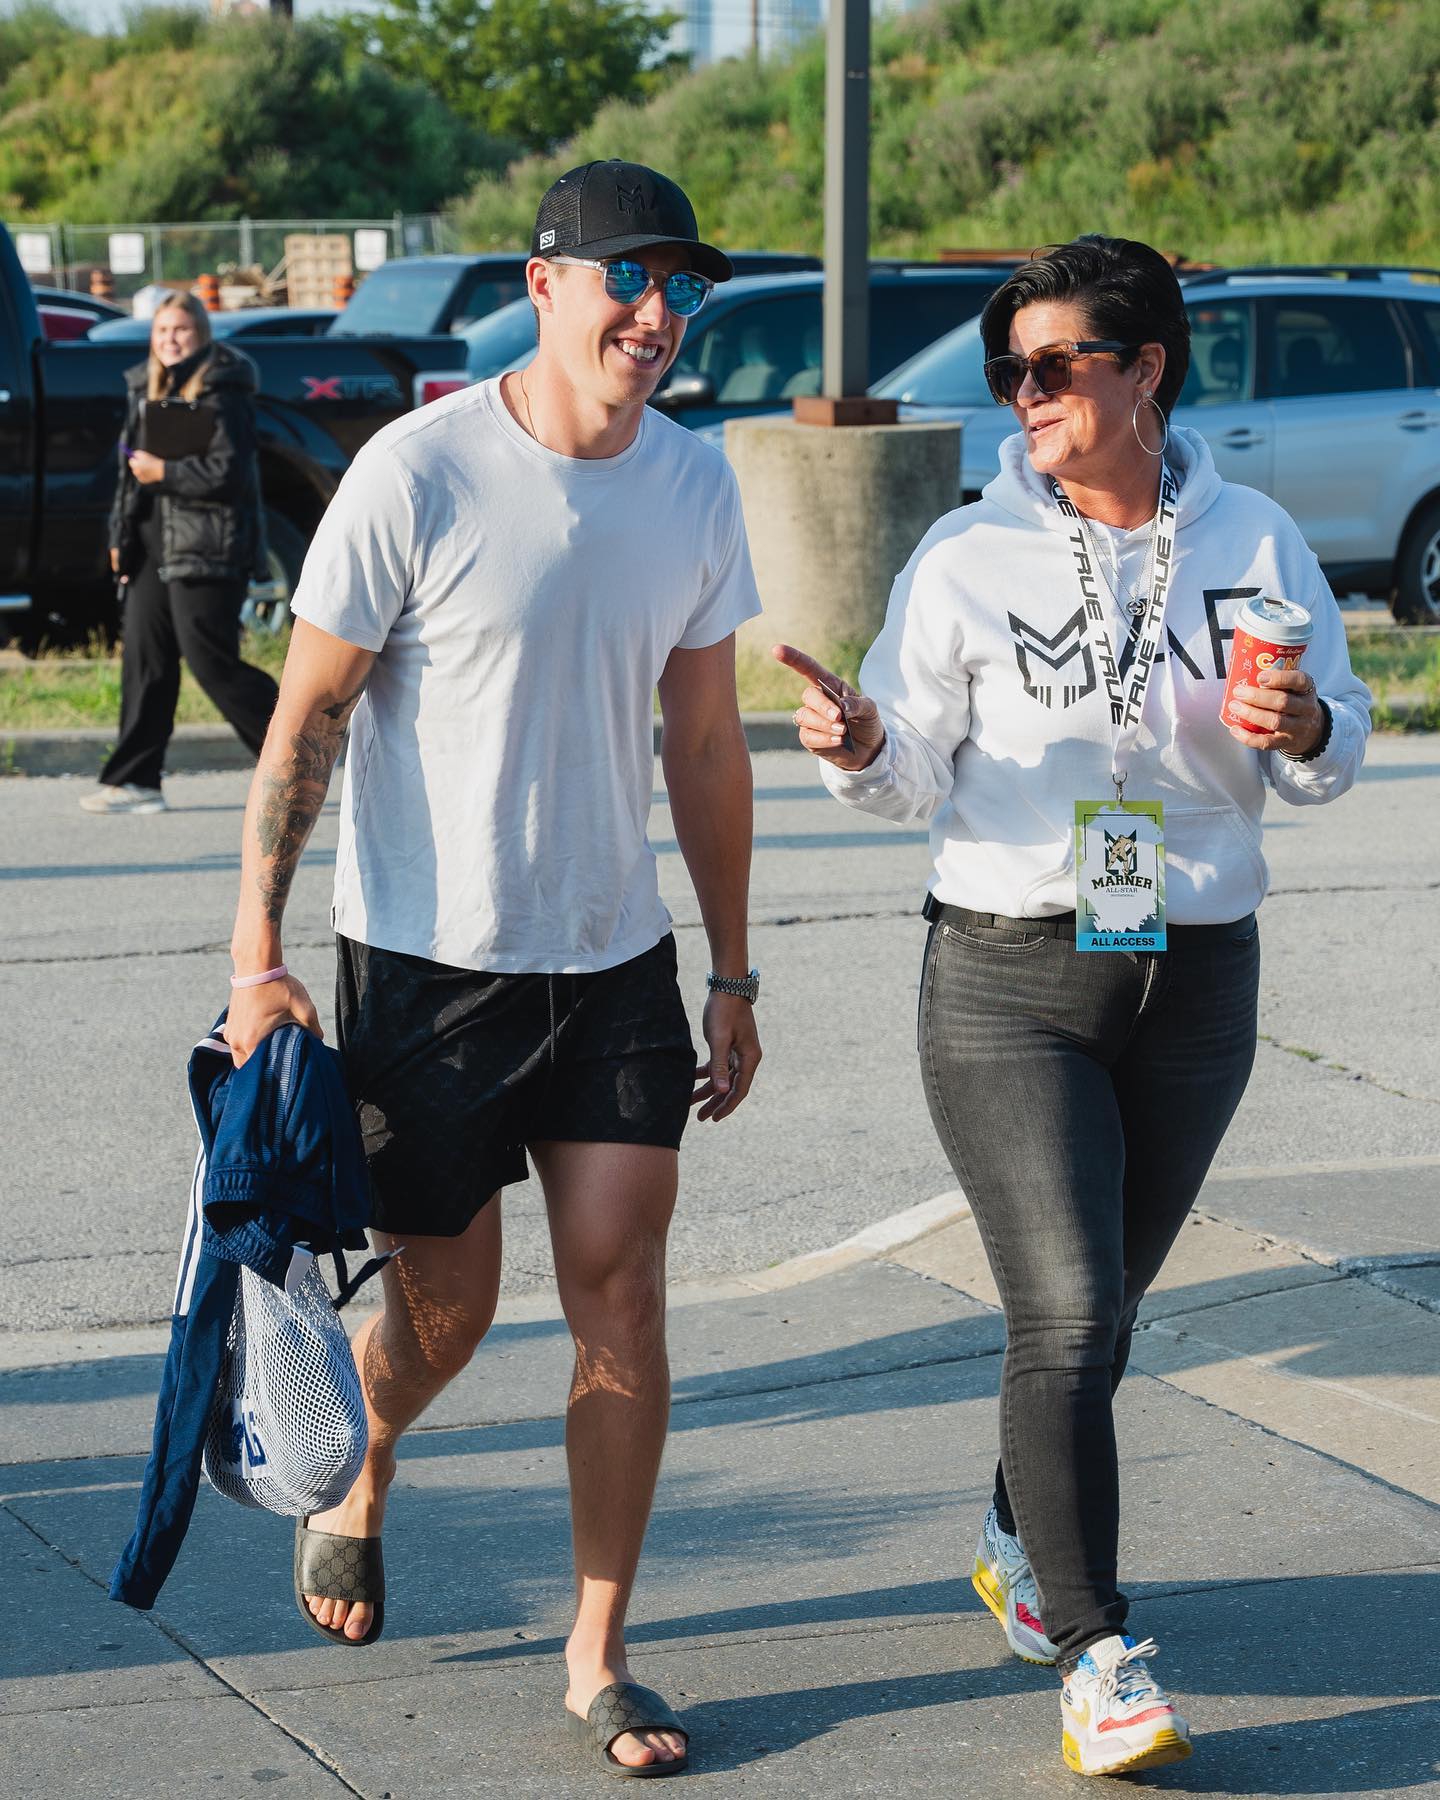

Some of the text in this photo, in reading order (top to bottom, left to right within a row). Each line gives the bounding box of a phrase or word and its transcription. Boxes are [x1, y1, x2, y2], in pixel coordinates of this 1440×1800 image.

[301, 376, 403, 400] XTR
[1069, 527, 1104, 621] TRUE
[1094, 630, 1124, 726] TRUE
[1123, 637, 1156, 730] TRUE
[1147, 534, 1172, 630] TRUE
[1091, 875, 1152, 889] MARNER
[1091, 937, 1155, 947] ALL ACCESS
